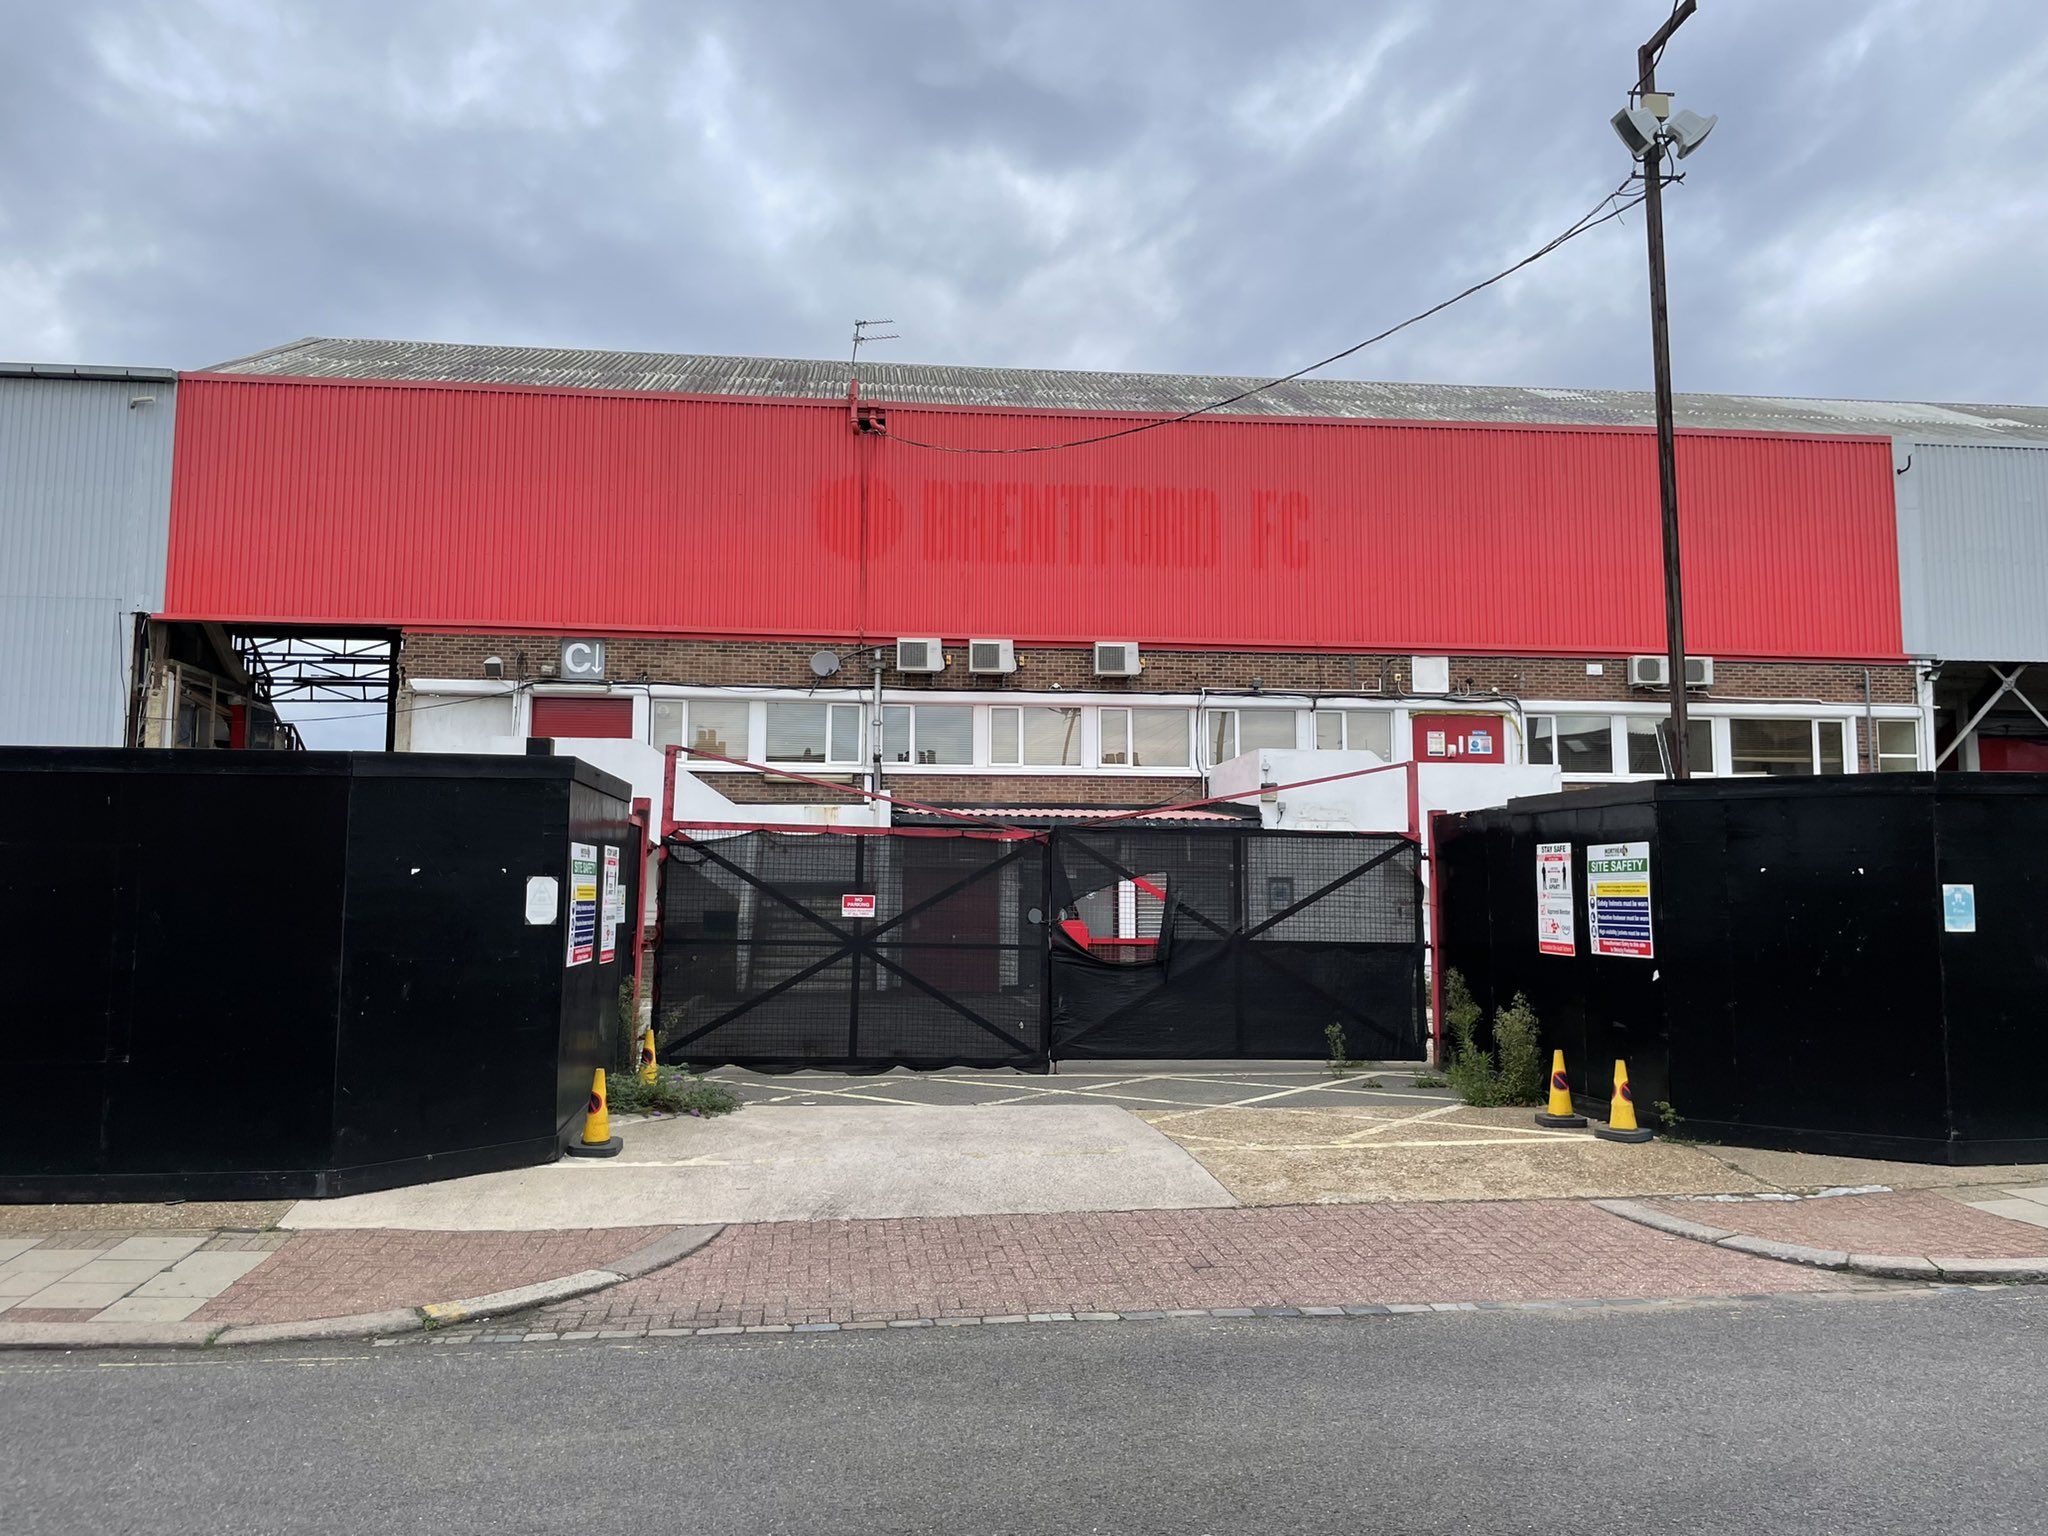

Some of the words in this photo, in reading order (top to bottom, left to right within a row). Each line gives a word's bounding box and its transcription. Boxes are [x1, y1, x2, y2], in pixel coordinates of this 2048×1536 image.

[923, 480, 1221, 568] BRENTFORD
[1252, 489, 1311, 570] FC
[565, 643, 592, 673] C
[1553, 845, 1566, 853] SAFE
[1590, 861, 1609, 872] SITE
[1610, 859, 1643, 872] SAFETY
